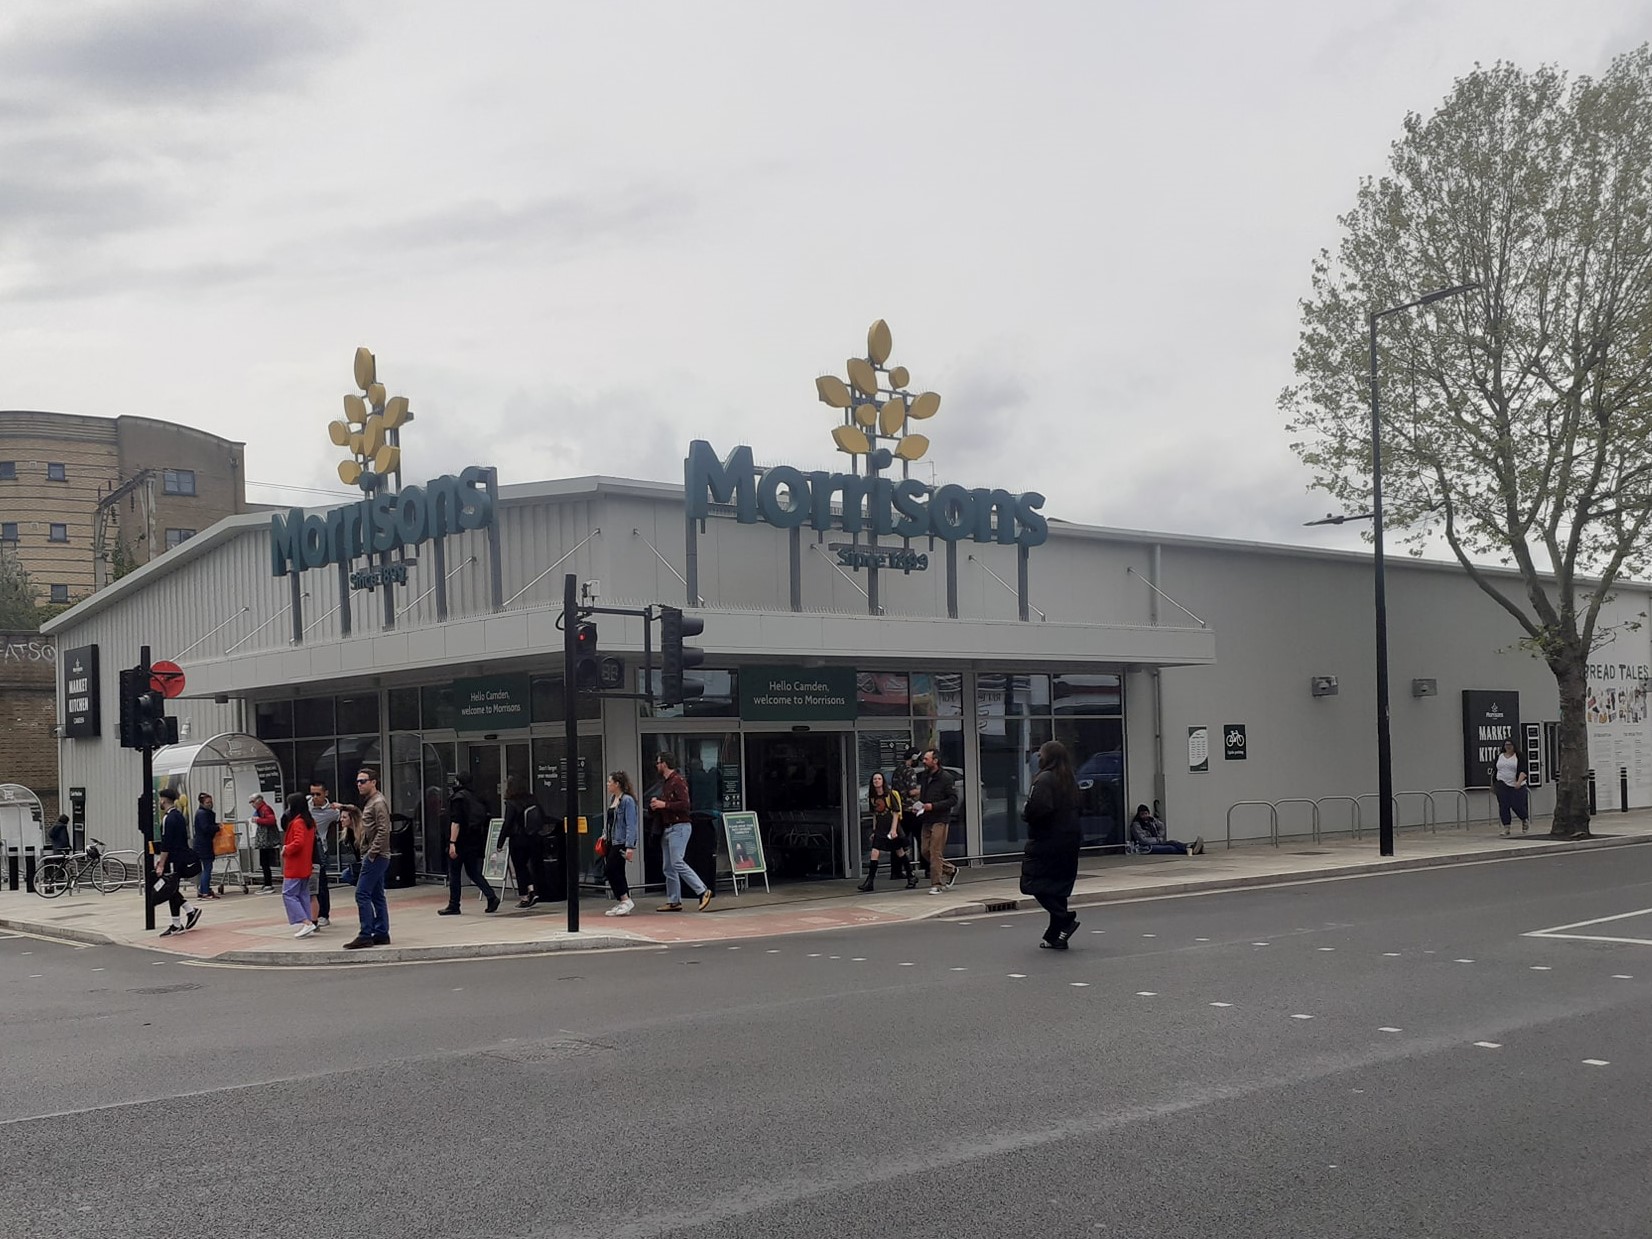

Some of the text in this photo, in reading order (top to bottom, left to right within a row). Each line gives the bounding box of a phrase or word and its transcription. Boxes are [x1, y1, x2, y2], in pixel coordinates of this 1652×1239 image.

[684, 439, 1048, 547] Morrisons
[271, 466, 493, 577] Morrisons
[837, 548, 929, 571] Since 1899
[350, 571, 376, 591] Since
[1584, 664, 1649, 681] BREAD TALES
[69, 678, 88, 694] MARKET
[769, 681, 830, 692] Hello Camden,
[470, 690, 510, 702] Hello Camden,
[753, 694, 845, 705] welcome to Morrisons
[69, 697, 88, 713] KITCHEN
[461, 703, 521, 716] welcome to Morrisons
[1478, 725, 1512, 741] MARKET
